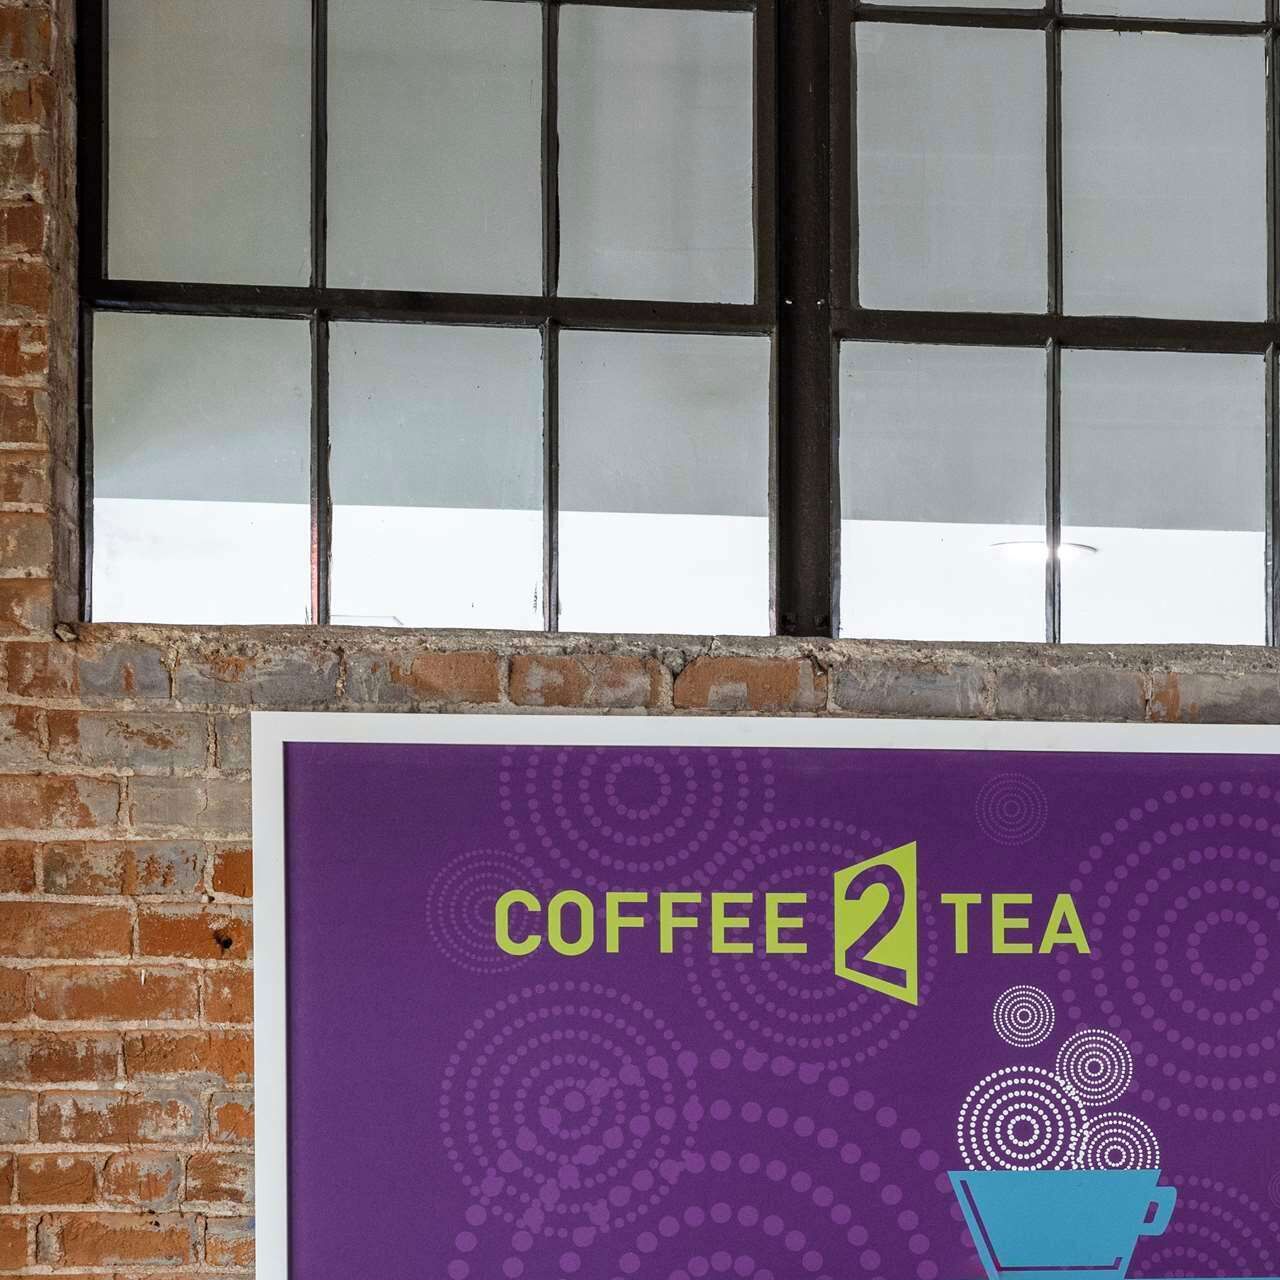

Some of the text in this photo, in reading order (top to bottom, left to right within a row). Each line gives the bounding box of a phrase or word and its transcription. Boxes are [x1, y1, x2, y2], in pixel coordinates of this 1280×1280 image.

[496, 856, 1088, 992] COFFEE 2 TEA
